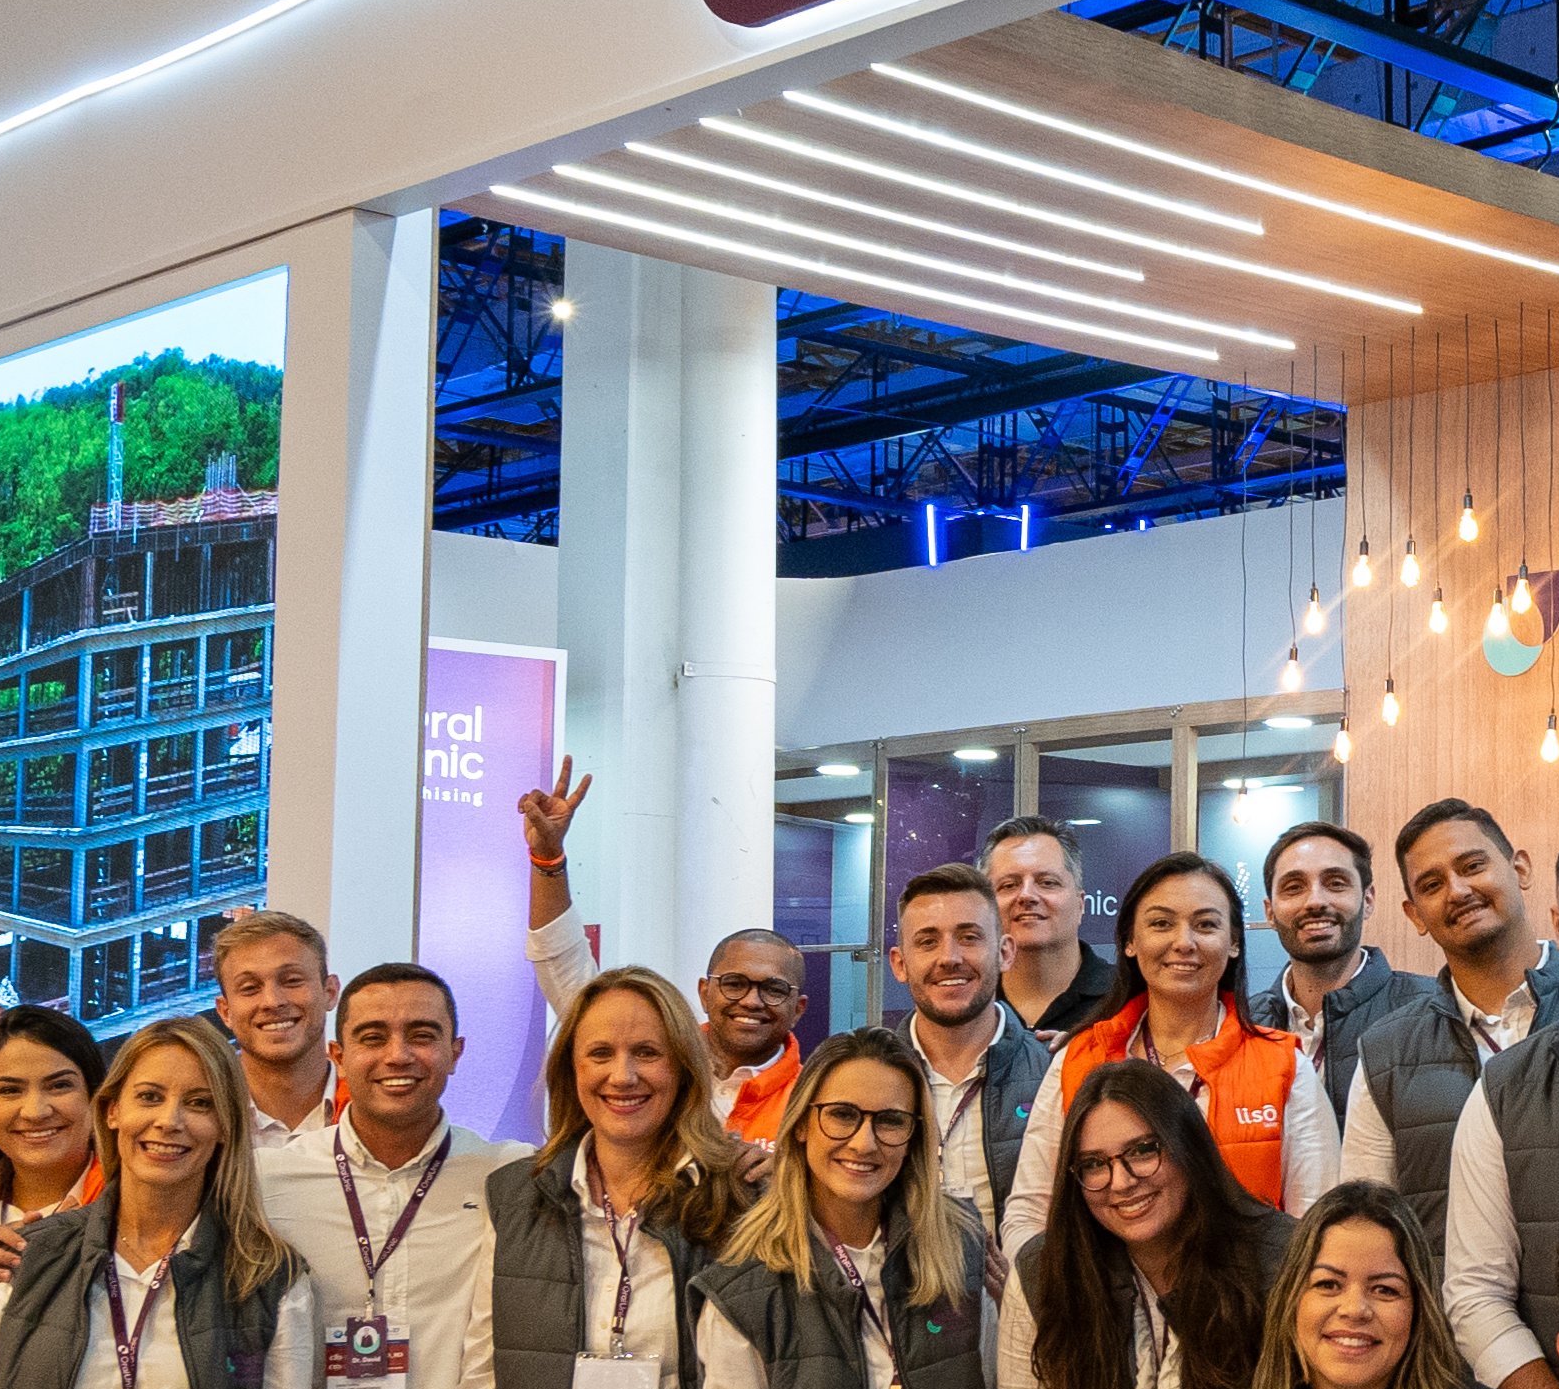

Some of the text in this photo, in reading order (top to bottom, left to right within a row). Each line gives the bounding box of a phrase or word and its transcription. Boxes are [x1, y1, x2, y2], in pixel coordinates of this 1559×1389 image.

[425, 705, 482, 742] ral
[424, 744, 484, 780] nic
[422, 786, 482, 807] hising
[1082, 889, 1118, 916] nic
[1235, 1104, 1278, 1125] lisô
[422, 1160, 441, 1190] OralUni
[120, 1356, 131, 1388] OralUni
